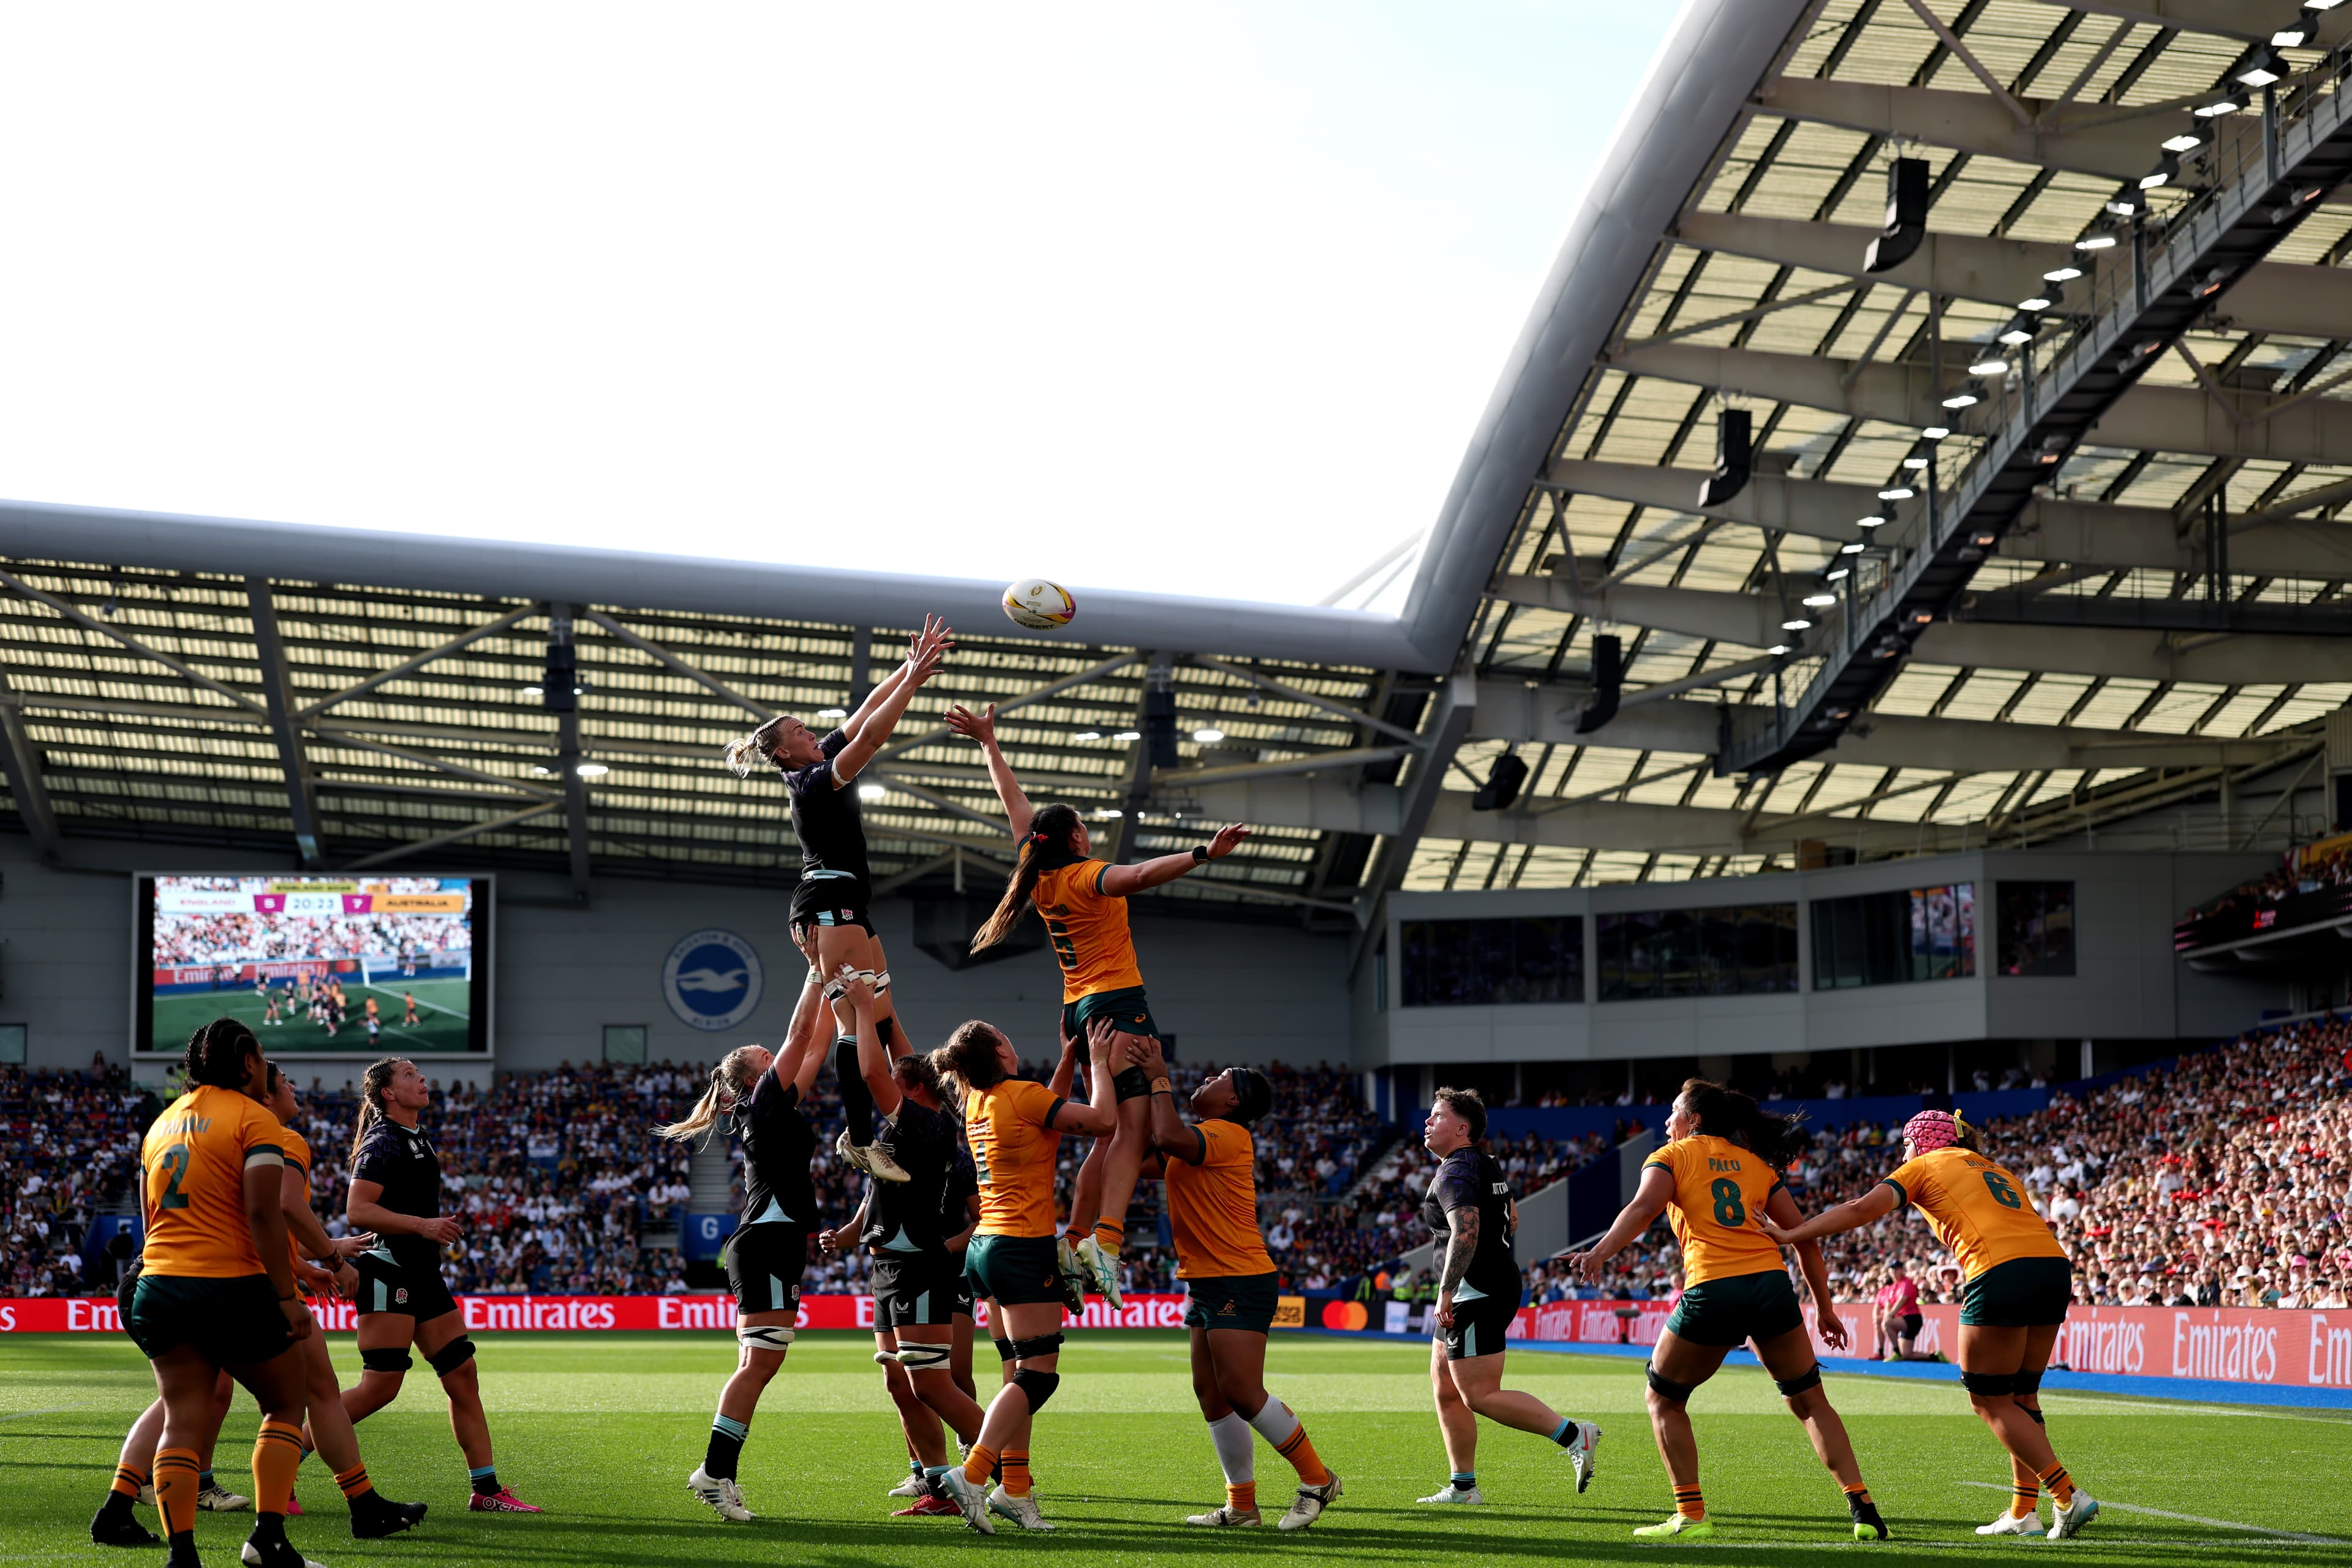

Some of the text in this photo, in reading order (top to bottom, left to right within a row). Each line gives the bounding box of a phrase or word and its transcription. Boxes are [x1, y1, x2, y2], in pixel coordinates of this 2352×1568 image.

[293, 898, 334, 909] 20:23
[353, 898, 363, 909] 7
[161, 1144, 189, 1210] 2
[1708, 1158, 1741, 1172] PALU
[1711, 1178, 1745, 1227] 8
[1982, 1171, 2021, 1209] 6
[701, 1216, 718, 1240] G
[463, 1295, 615, 1329] Emirates
[1534, 1298, 1572, 1341] Emirates
[1580, 1303, 1619, 1343] Emirates
[2173, 1310, 2277, 1382] Emirates
